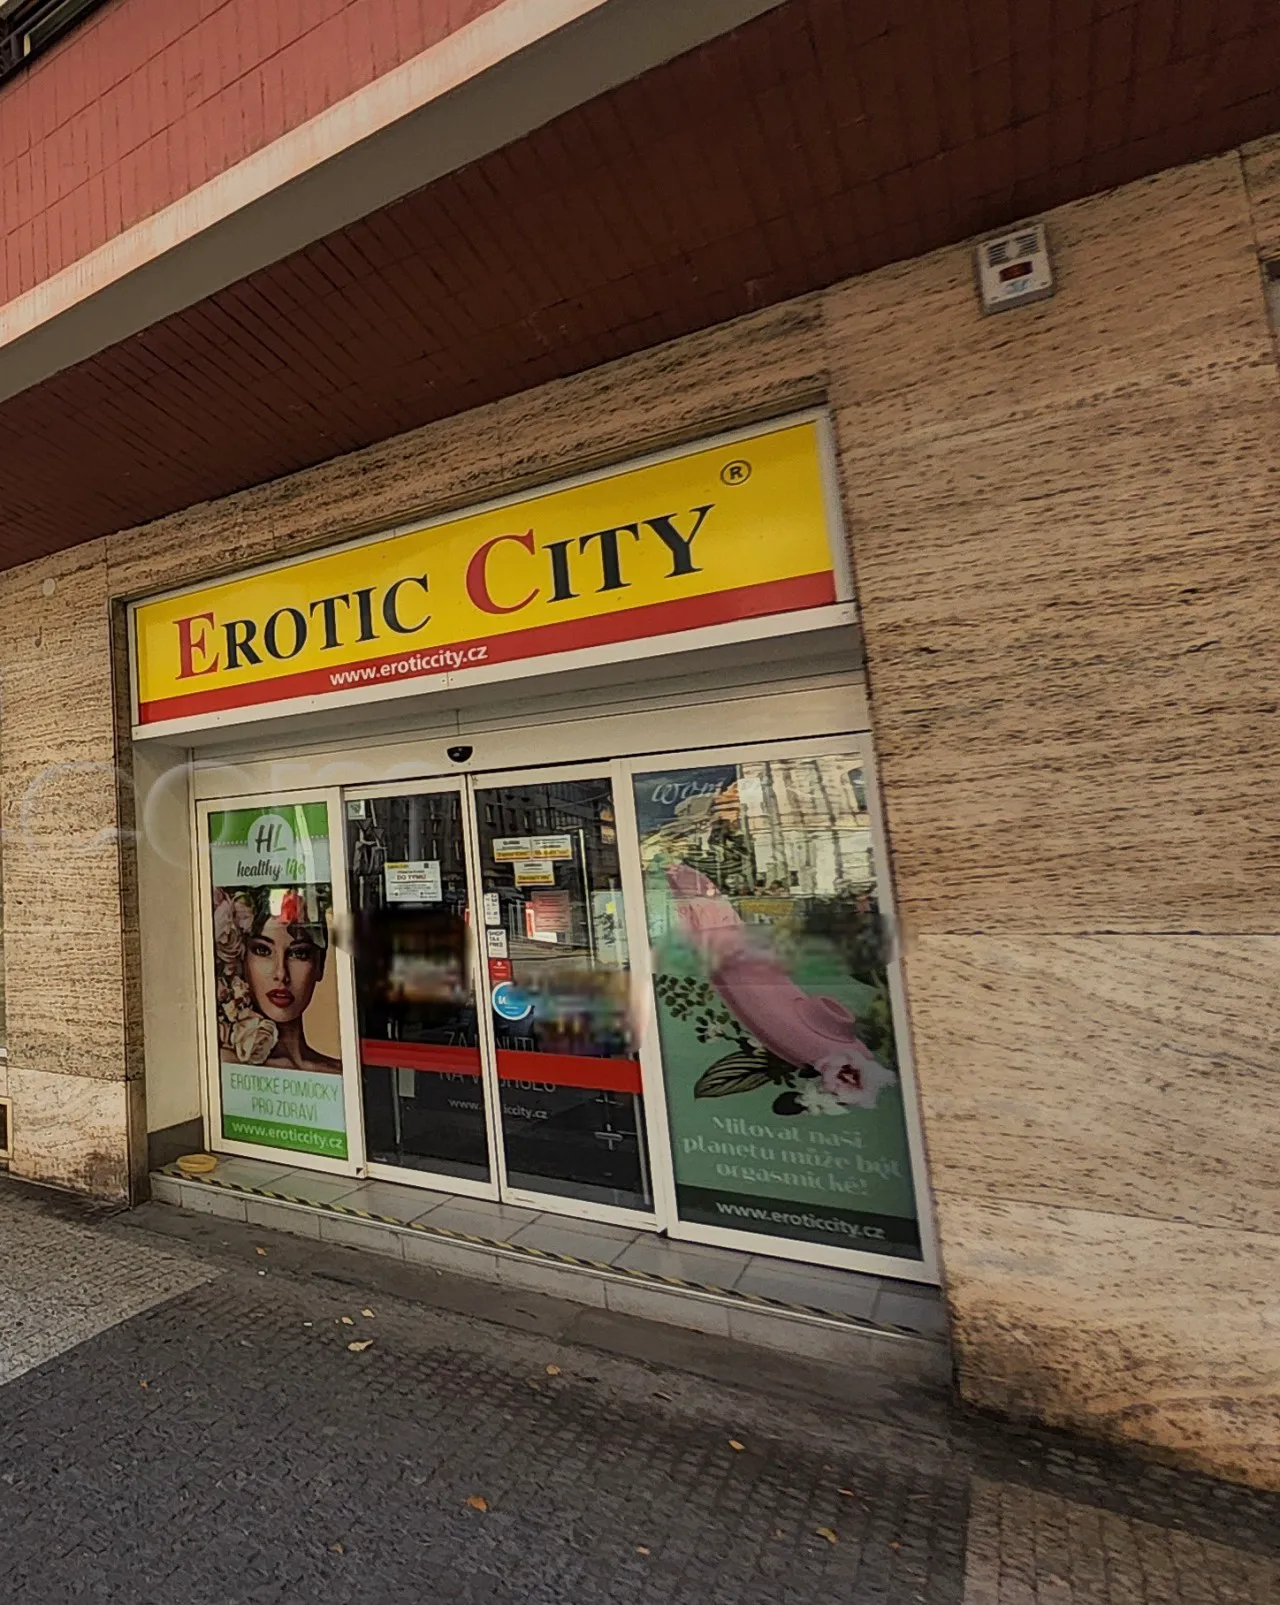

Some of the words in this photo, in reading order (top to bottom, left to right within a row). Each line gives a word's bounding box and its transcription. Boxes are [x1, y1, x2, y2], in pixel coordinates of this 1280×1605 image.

[173, 573, 431, 681] EROTIC
[466, 503, 716, 615] CITY
[329, 645, 488, 687] www.eroticcity.cz
[255, 824, 287, 853] HL
[237, 859, 282, 882] healthy
[285, 857, 306, 881] life
[252, 1096, 274, 1116] PRO
[232, 1122, 343, 1148] www.eroticcity.cz
[683, 1135, 775, 1161] planetu
[715, 1200, 886, 1240] www.eroticcity.cz
